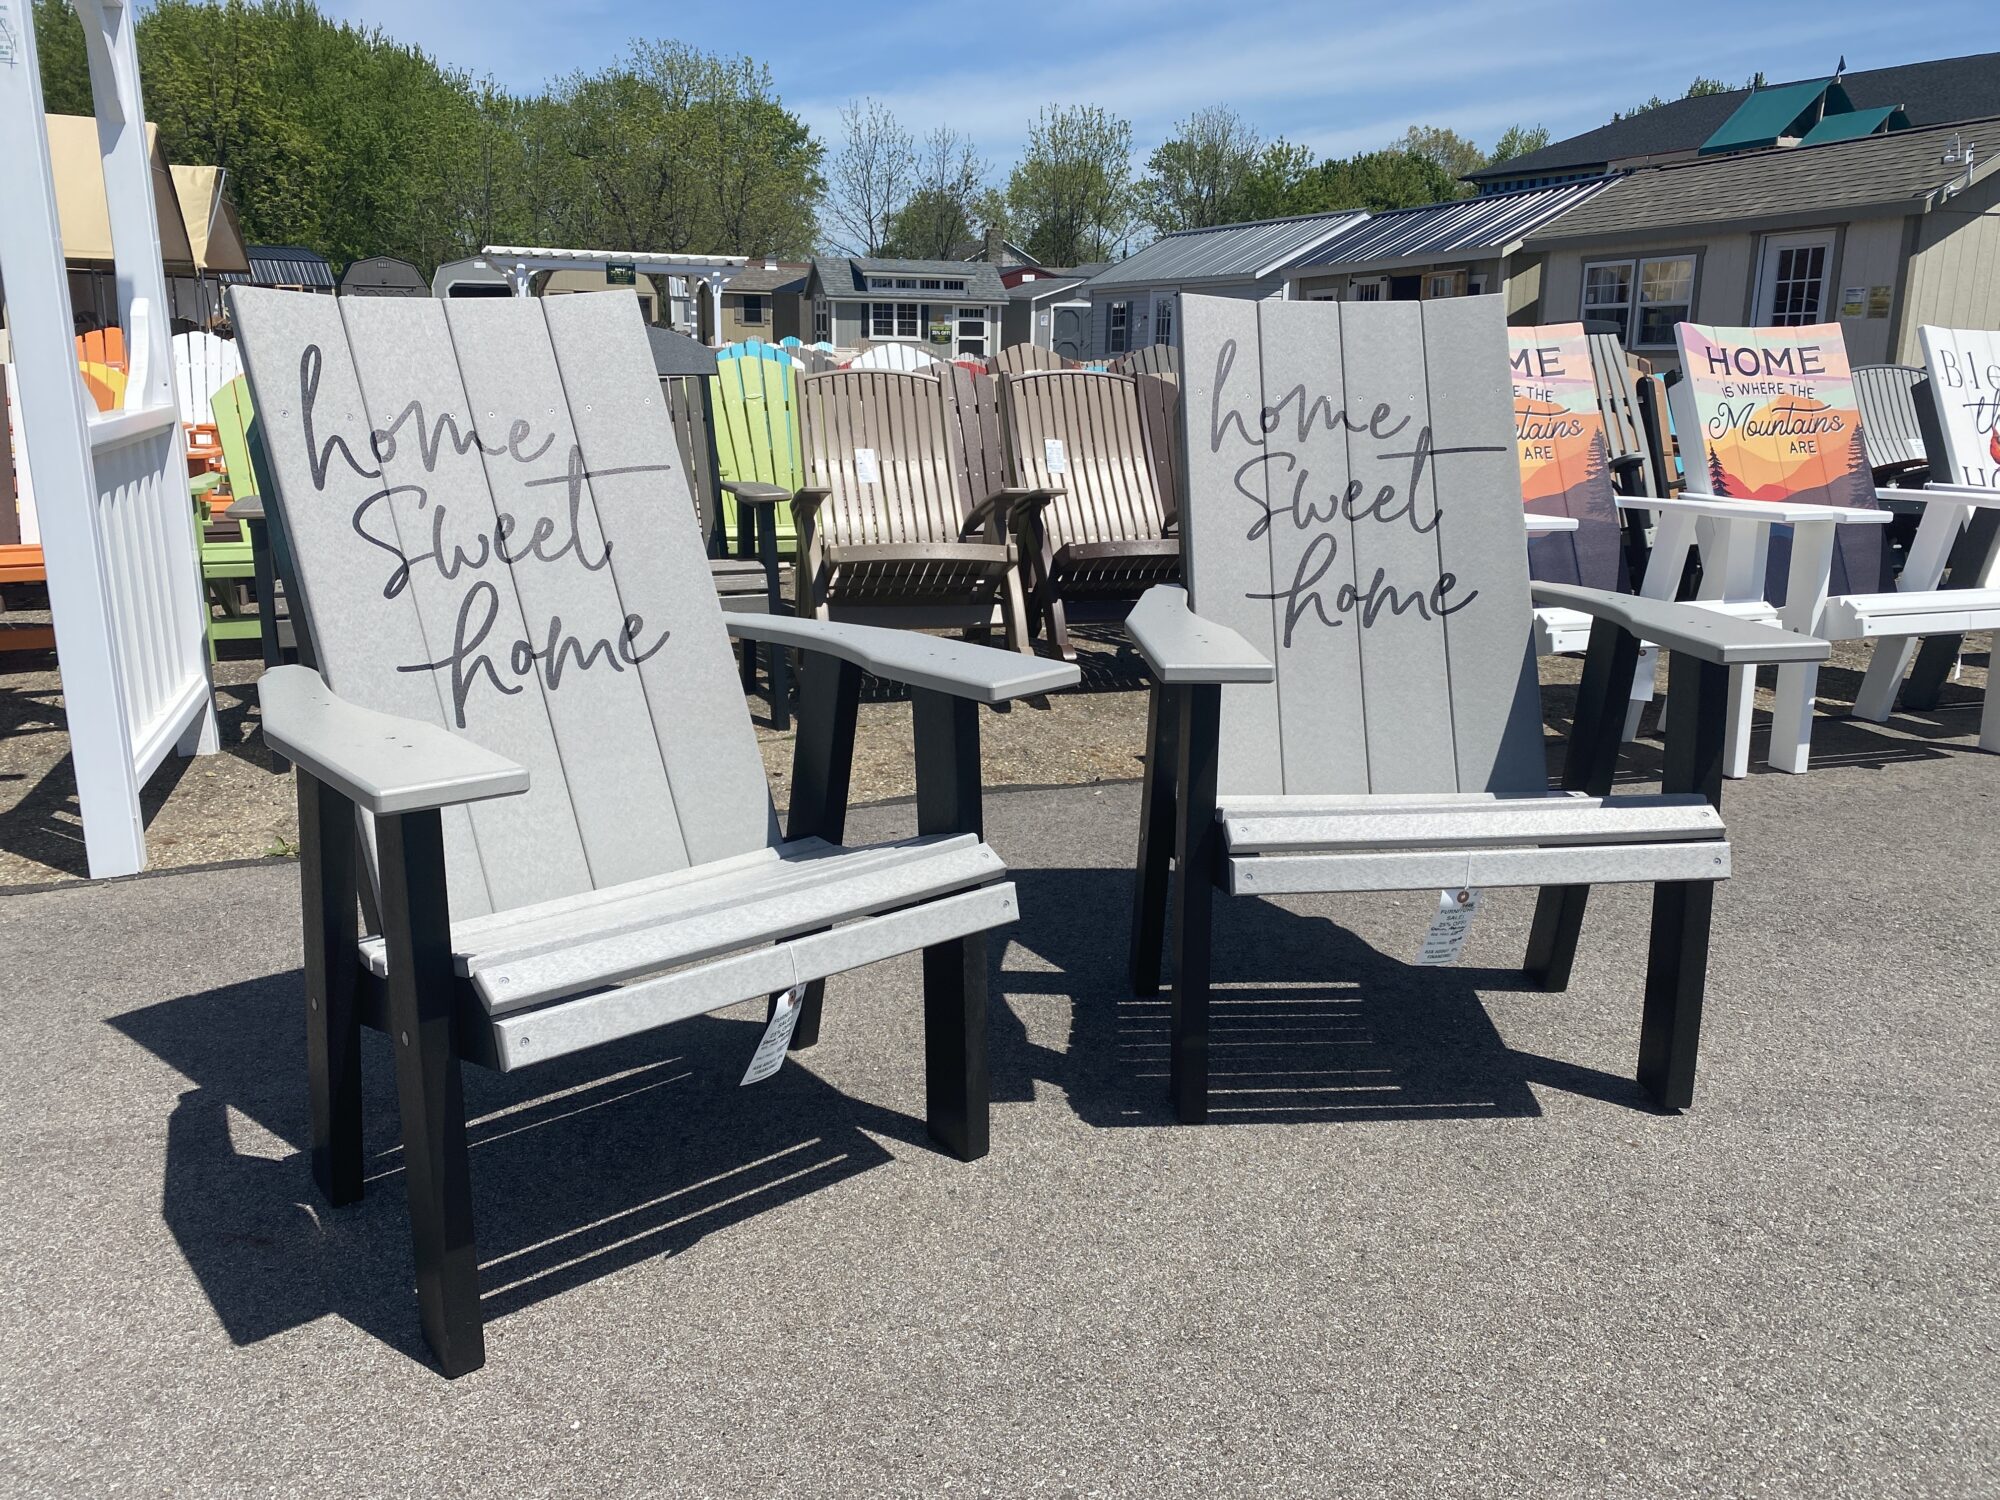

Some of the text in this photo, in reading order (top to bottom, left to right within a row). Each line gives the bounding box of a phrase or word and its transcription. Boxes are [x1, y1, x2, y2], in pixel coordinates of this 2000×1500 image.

[1510, 347, 1565, 377] ME
[1705, 346, 1825, 376] HOME
[1211, 339, 1411, 453] home
[1526, 386, 1554, 402] THE
[1722, 383, 1815, 399] IS WHERE THE
[300, 344, 555, 490] home
[1515, 405, 1583, 440] tains
[1709, 402, 1844, 441] Mountains
[1524, 446, 1553, 460] ARE
[1790, 441, 1817, 453] ARE
[1245, 532, 1478, 648] home
[397, 580, 670, 729] home
